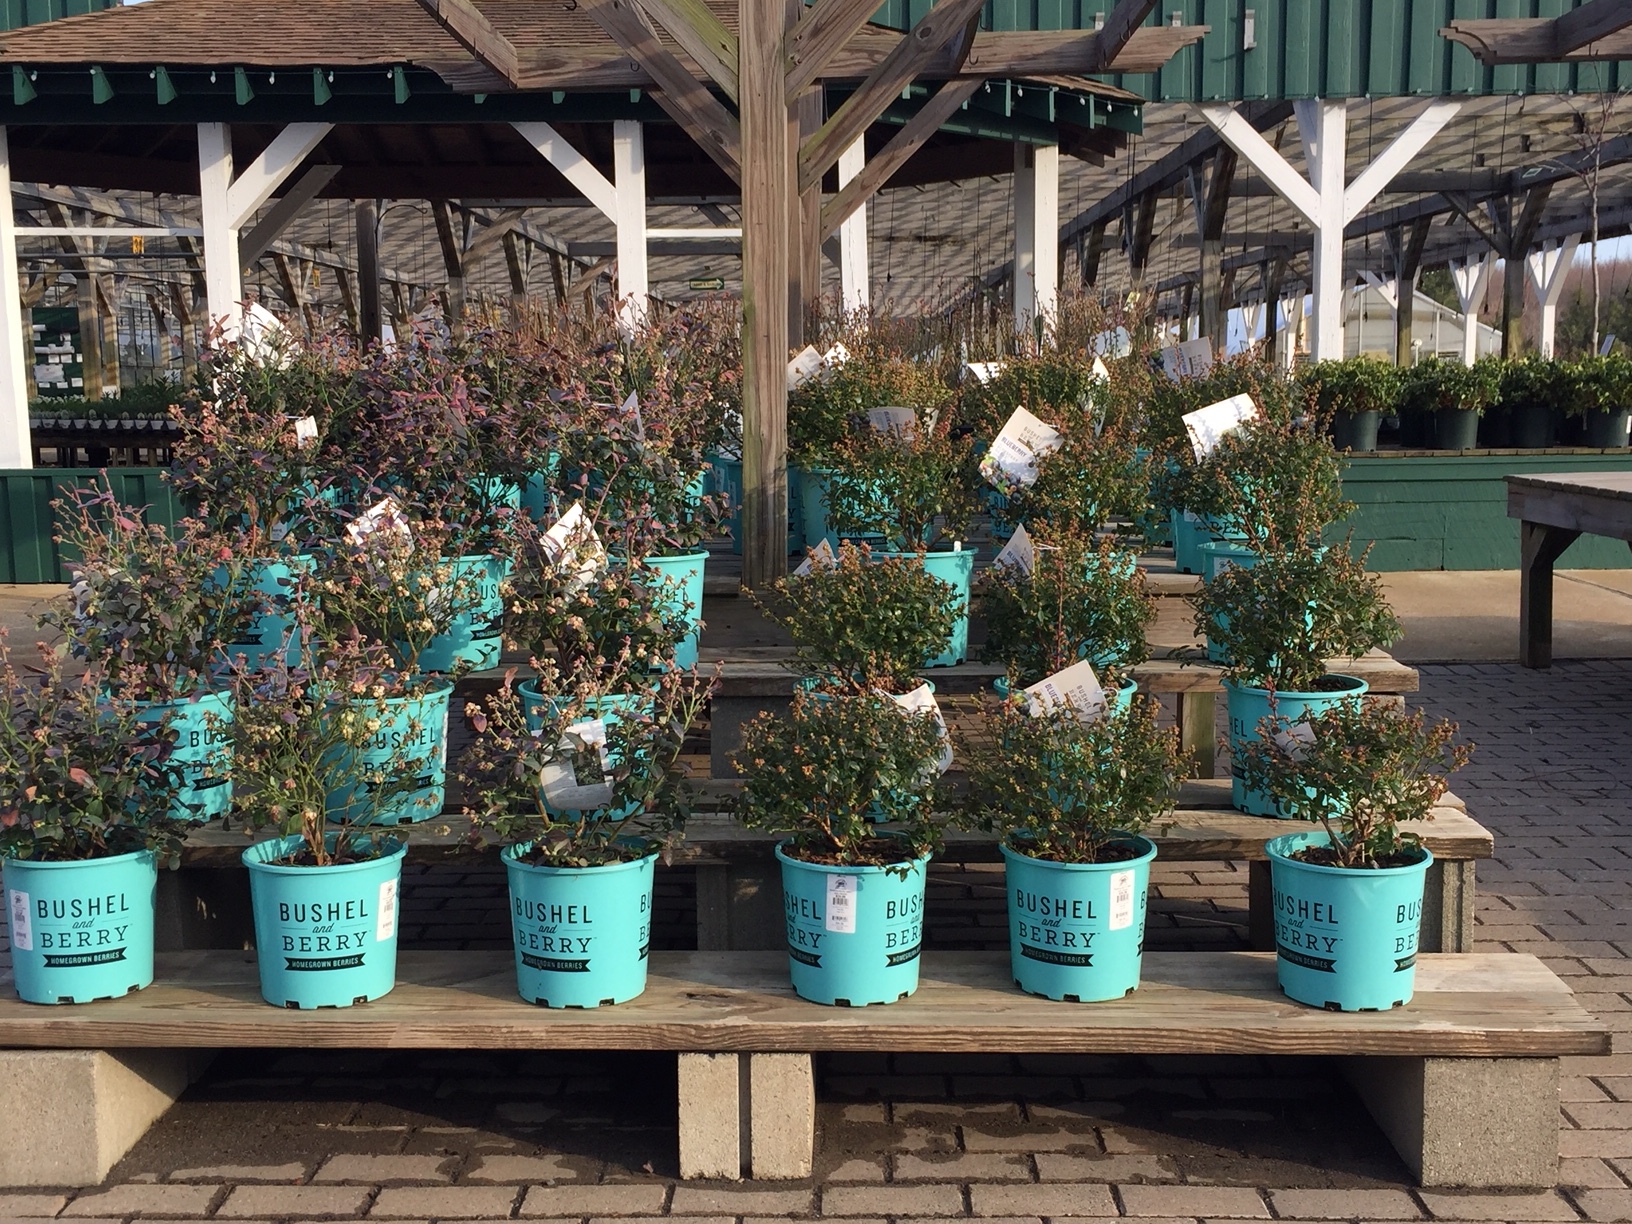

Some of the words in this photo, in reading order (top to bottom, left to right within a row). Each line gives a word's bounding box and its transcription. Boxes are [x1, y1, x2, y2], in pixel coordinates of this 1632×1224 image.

[37, 893, 129, 919] BUSHEL
[279, 899, 368, 923] BUSHEL
[516, 896, 592, 924] BUSHEL
[1017, 889, 1097, 919] BUSHEL
[72, 917, 95, 929] and
[312, 923, 334, 933] and
[538, 924, 557, 934] and
[1041, 918, 1062, 928] and
[1288, 918, 1304, 929] and
[40, 925, 128, 948] BERRY
[282, 931, 367, 952] BERRY
[518, 929, 592, 953] BERRY
[1018, 921, 1095, 948] BERRY
[50, 955, 92, 965] HOMEGROWN
[93, 951, 120, 962] BERRIES
[292, 960, 331, 968] HOMEGROWN
[333, 957, 359, 967] BERRIES
